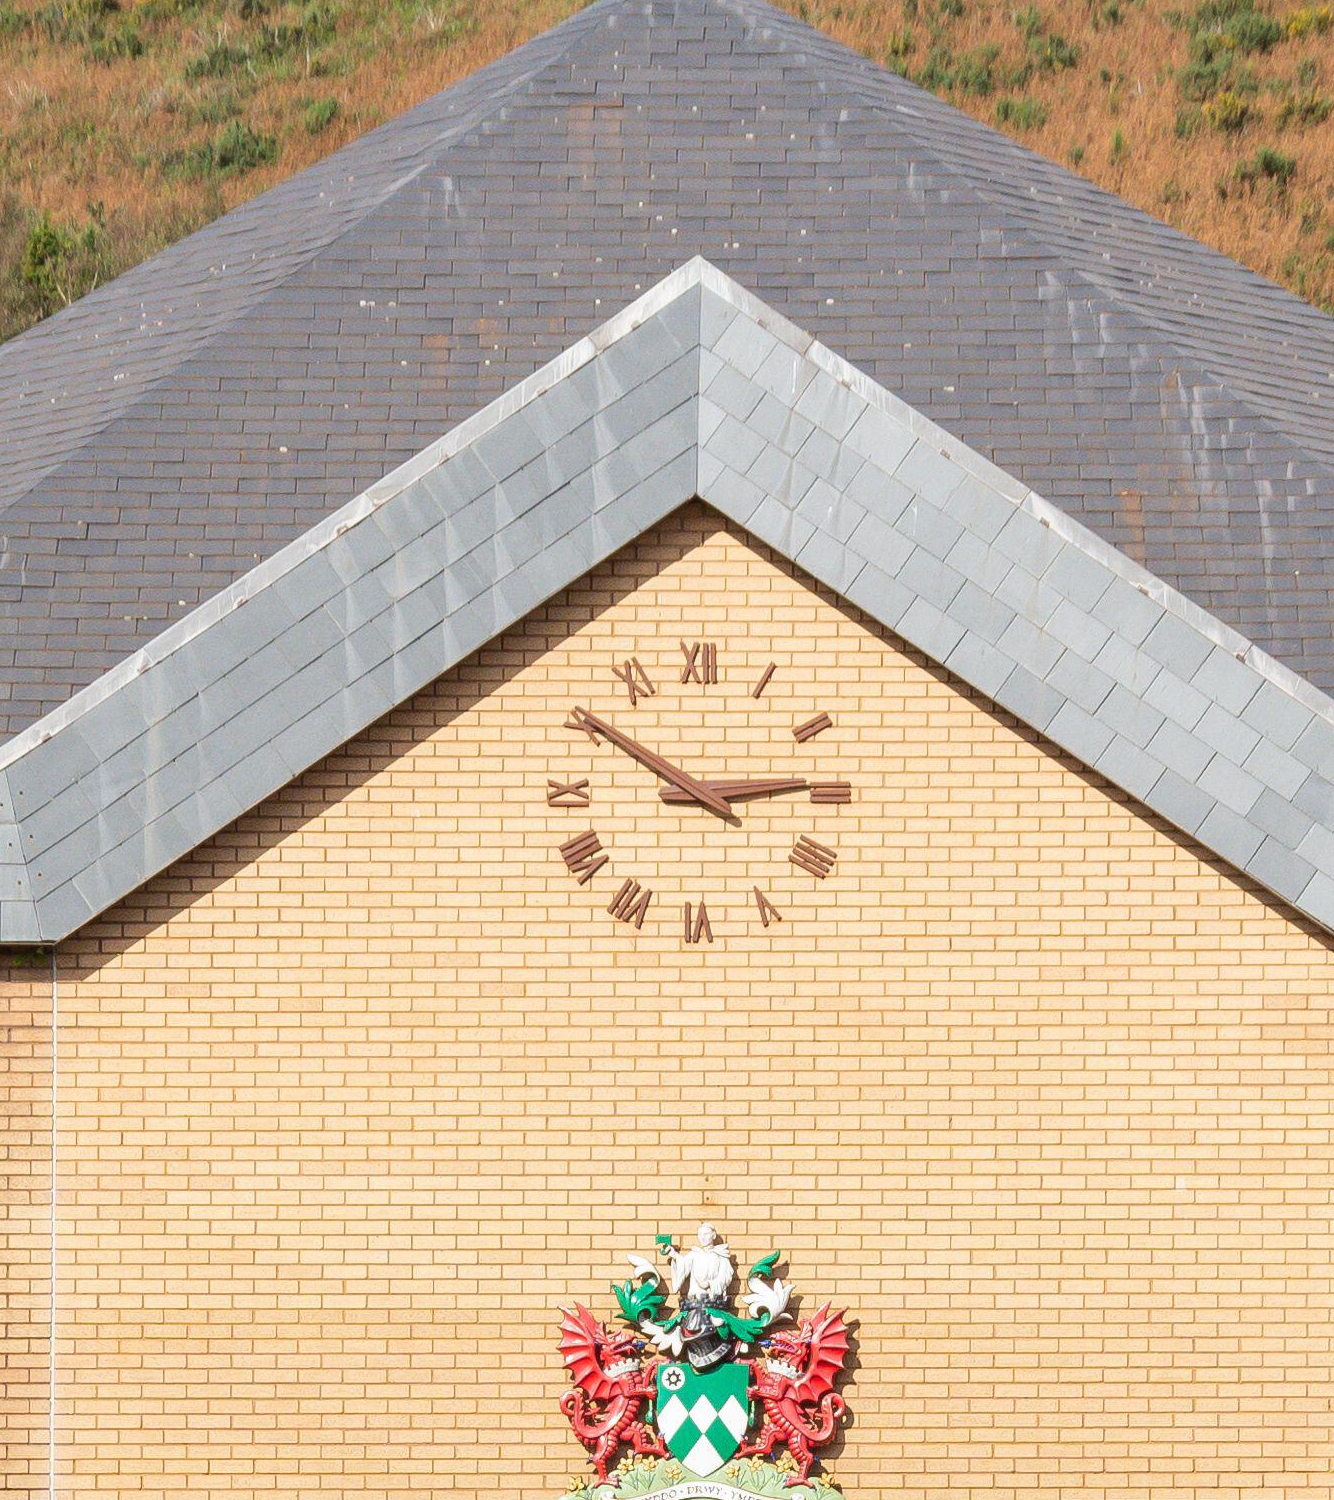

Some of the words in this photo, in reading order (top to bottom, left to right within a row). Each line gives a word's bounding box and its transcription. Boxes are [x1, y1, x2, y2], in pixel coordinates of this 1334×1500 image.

[611, 656, 656, 706] XI
[679, 641, 718, 685] XII
[791, 711, 833, 744] II
[547, 777, 589, 808] IX
[809, 781, 852, 805] III
[684, 900, 715, 944] VI
[752, 885, 783, 928] V
[686, 1485, 723, 1496] DRWY
